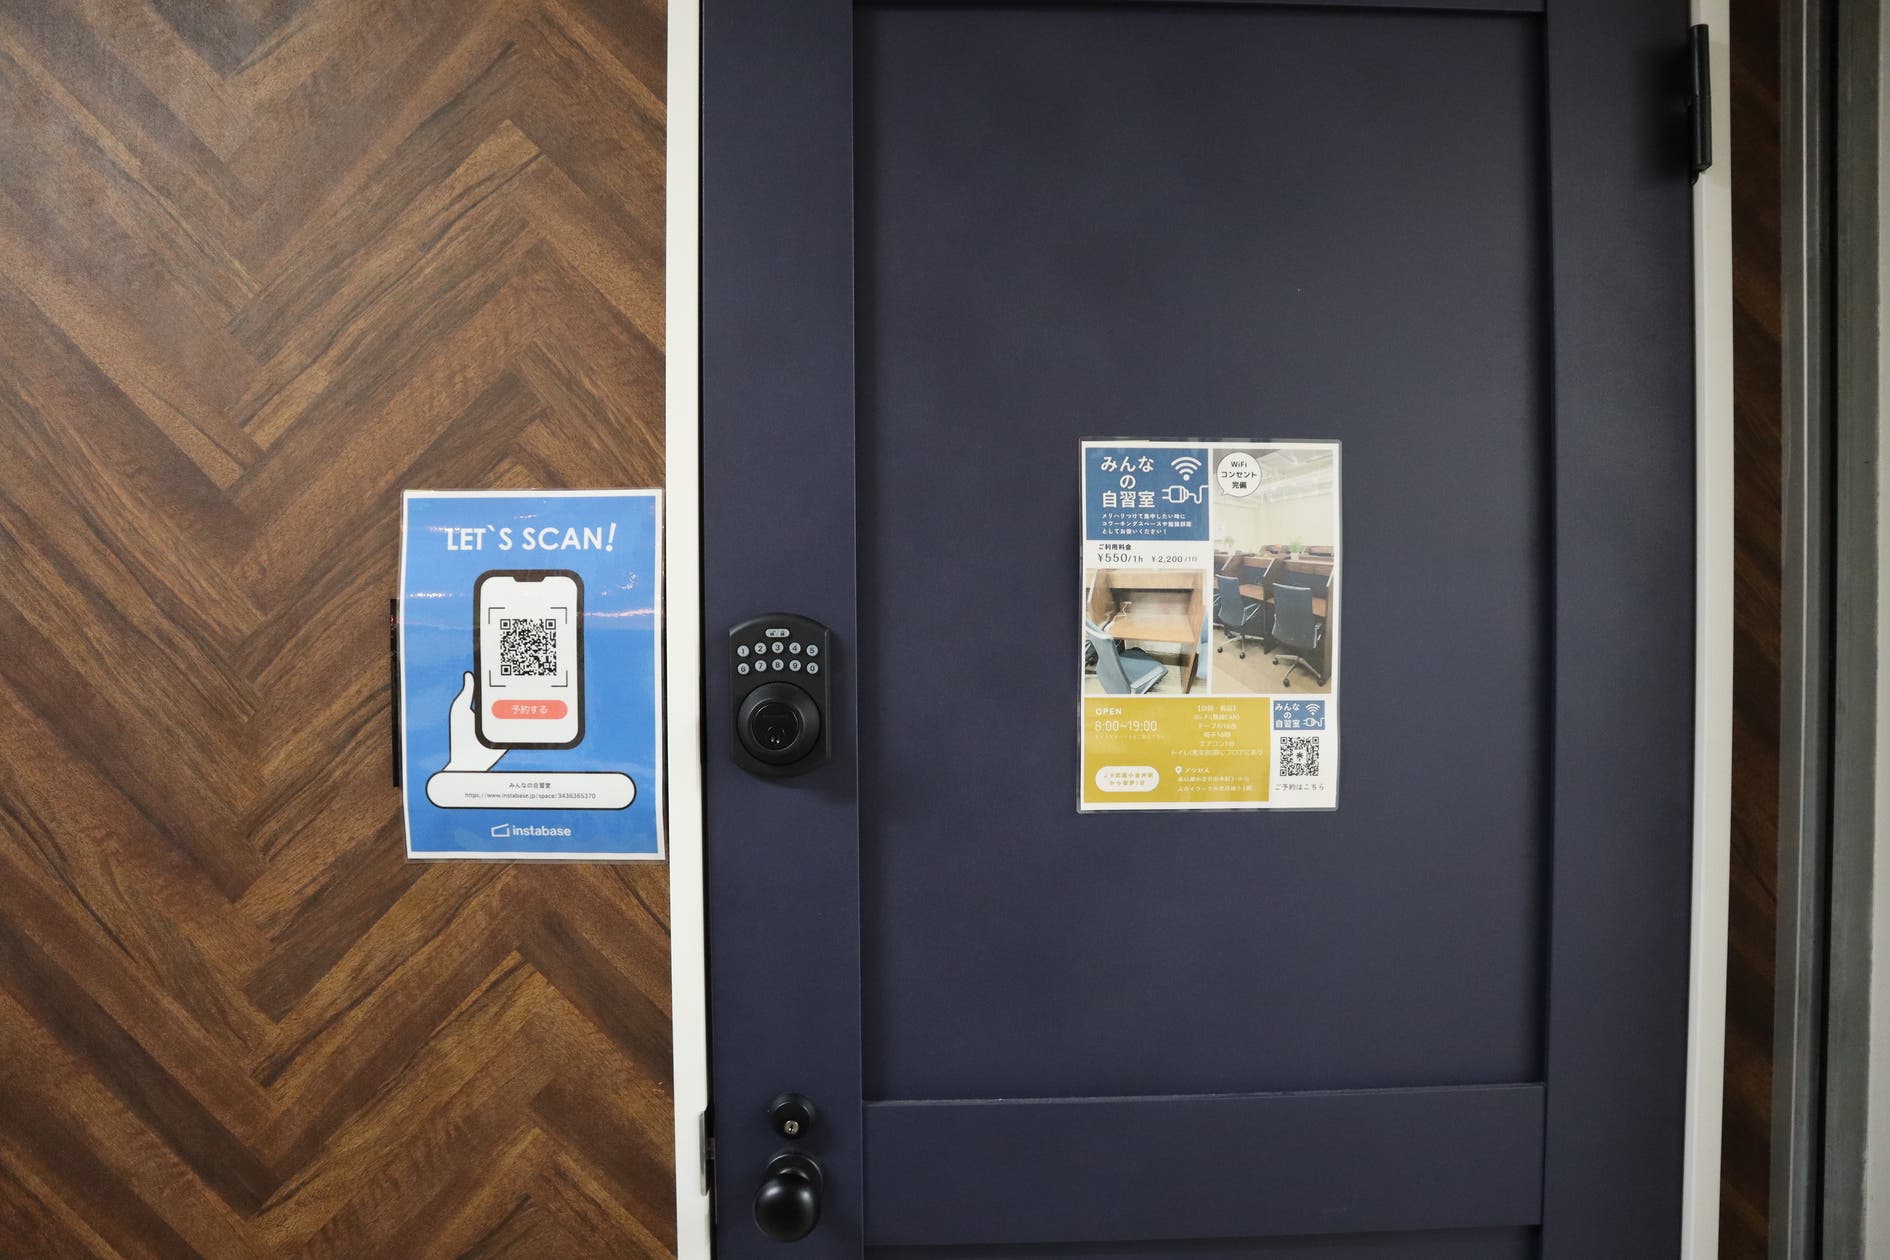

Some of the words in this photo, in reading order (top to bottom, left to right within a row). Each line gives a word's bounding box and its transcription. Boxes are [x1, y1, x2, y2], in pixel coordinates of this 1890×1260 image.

[1101, 456, 1154, 472] みんな
[1221, 471, 1257, 479] コンセント
[1119, 474, 1136, 489] の
[1231, 481, 1248, 489] 完備
[1102, 490, 1155, 508] 自習室
[521, 522, 617, 552] SCAN!
[512, 704, 549, 715] 予約する
[1095, 707, 1122, 716] OPEN
[1275, 703, 1300, 711] みんな
[1283, 711, 1292, 719] の
[512, 825, 572, 837] instabase
